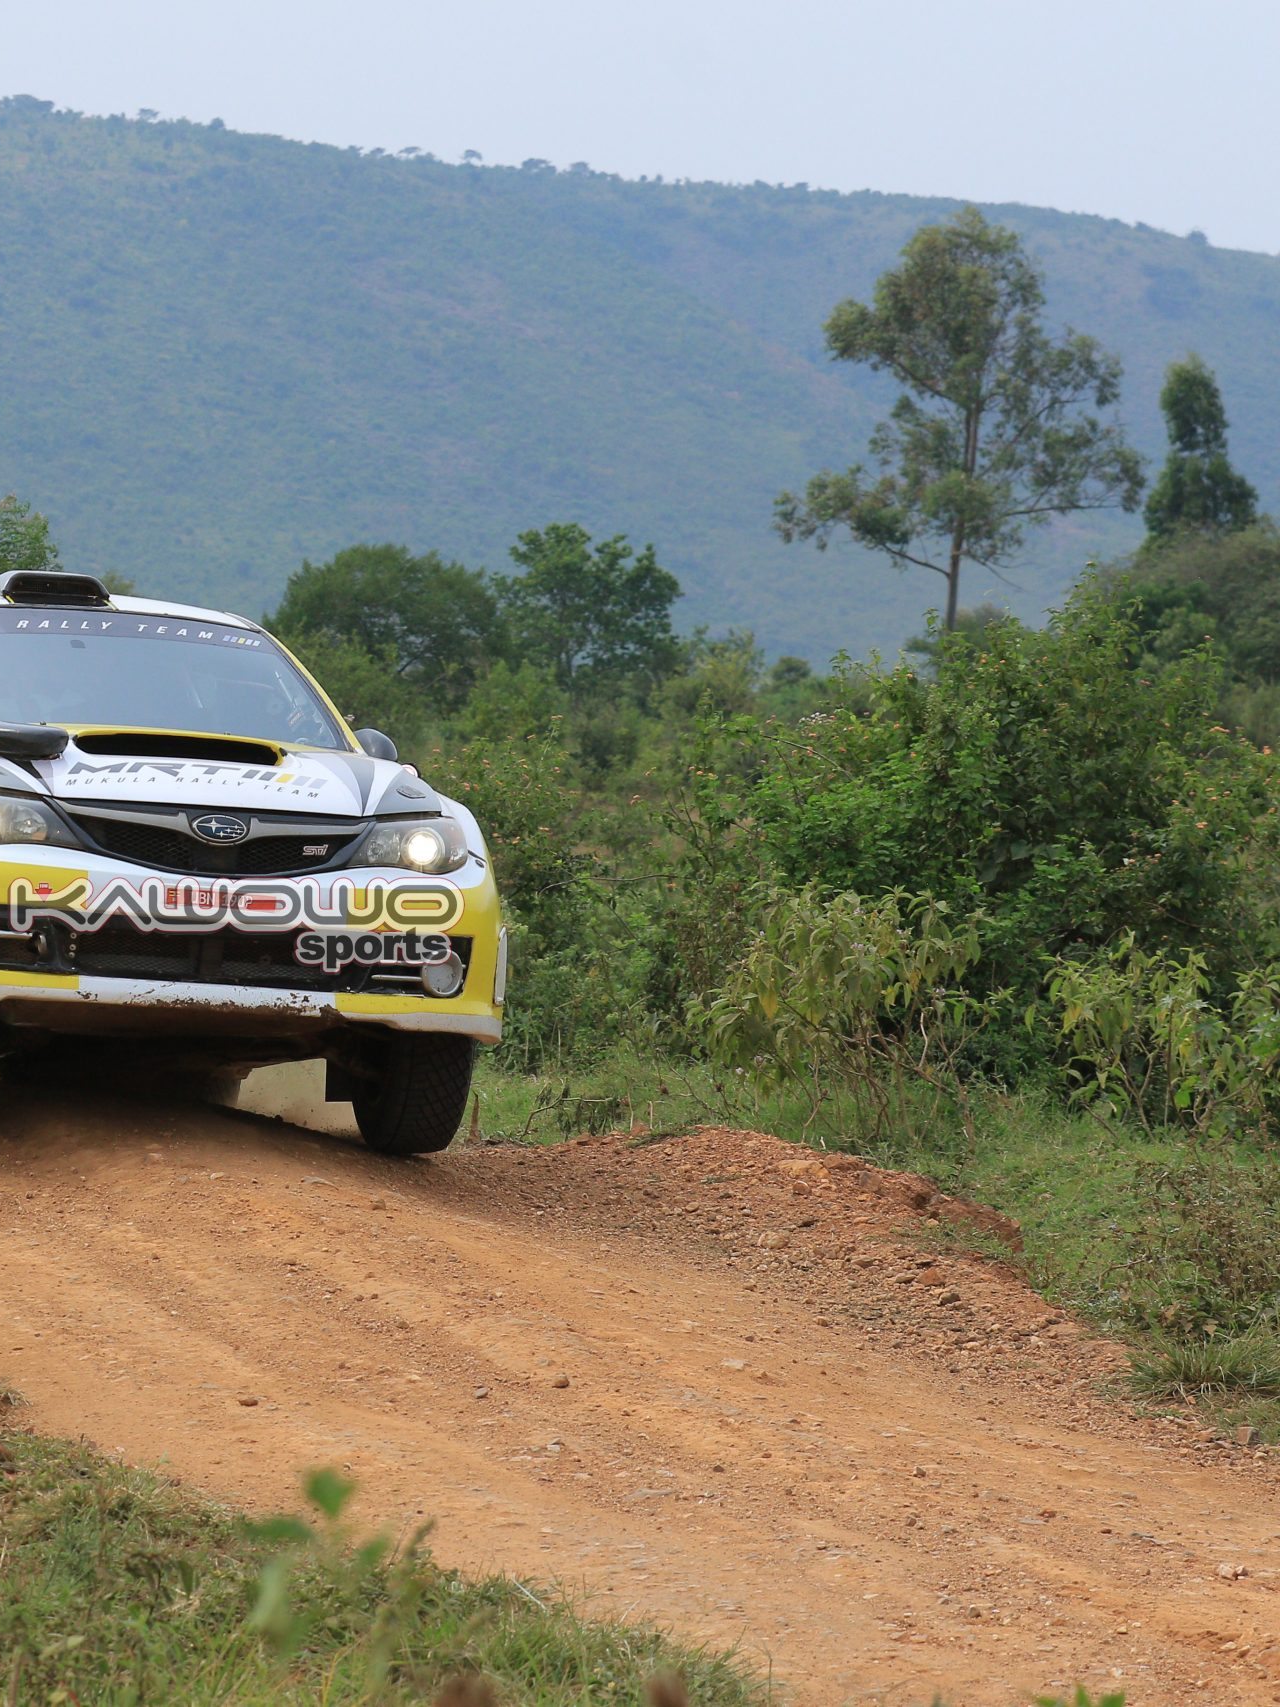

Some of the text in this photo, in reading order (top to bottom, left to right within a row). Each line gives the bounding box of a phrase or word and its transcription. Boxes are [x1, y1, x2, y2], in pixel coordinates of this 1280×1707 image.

[16, 619, 113, 631] RALLY
[137, 622, 214, 640] TEAM
[65, 776, 320, 799] MUKULA RALLY TEAM
